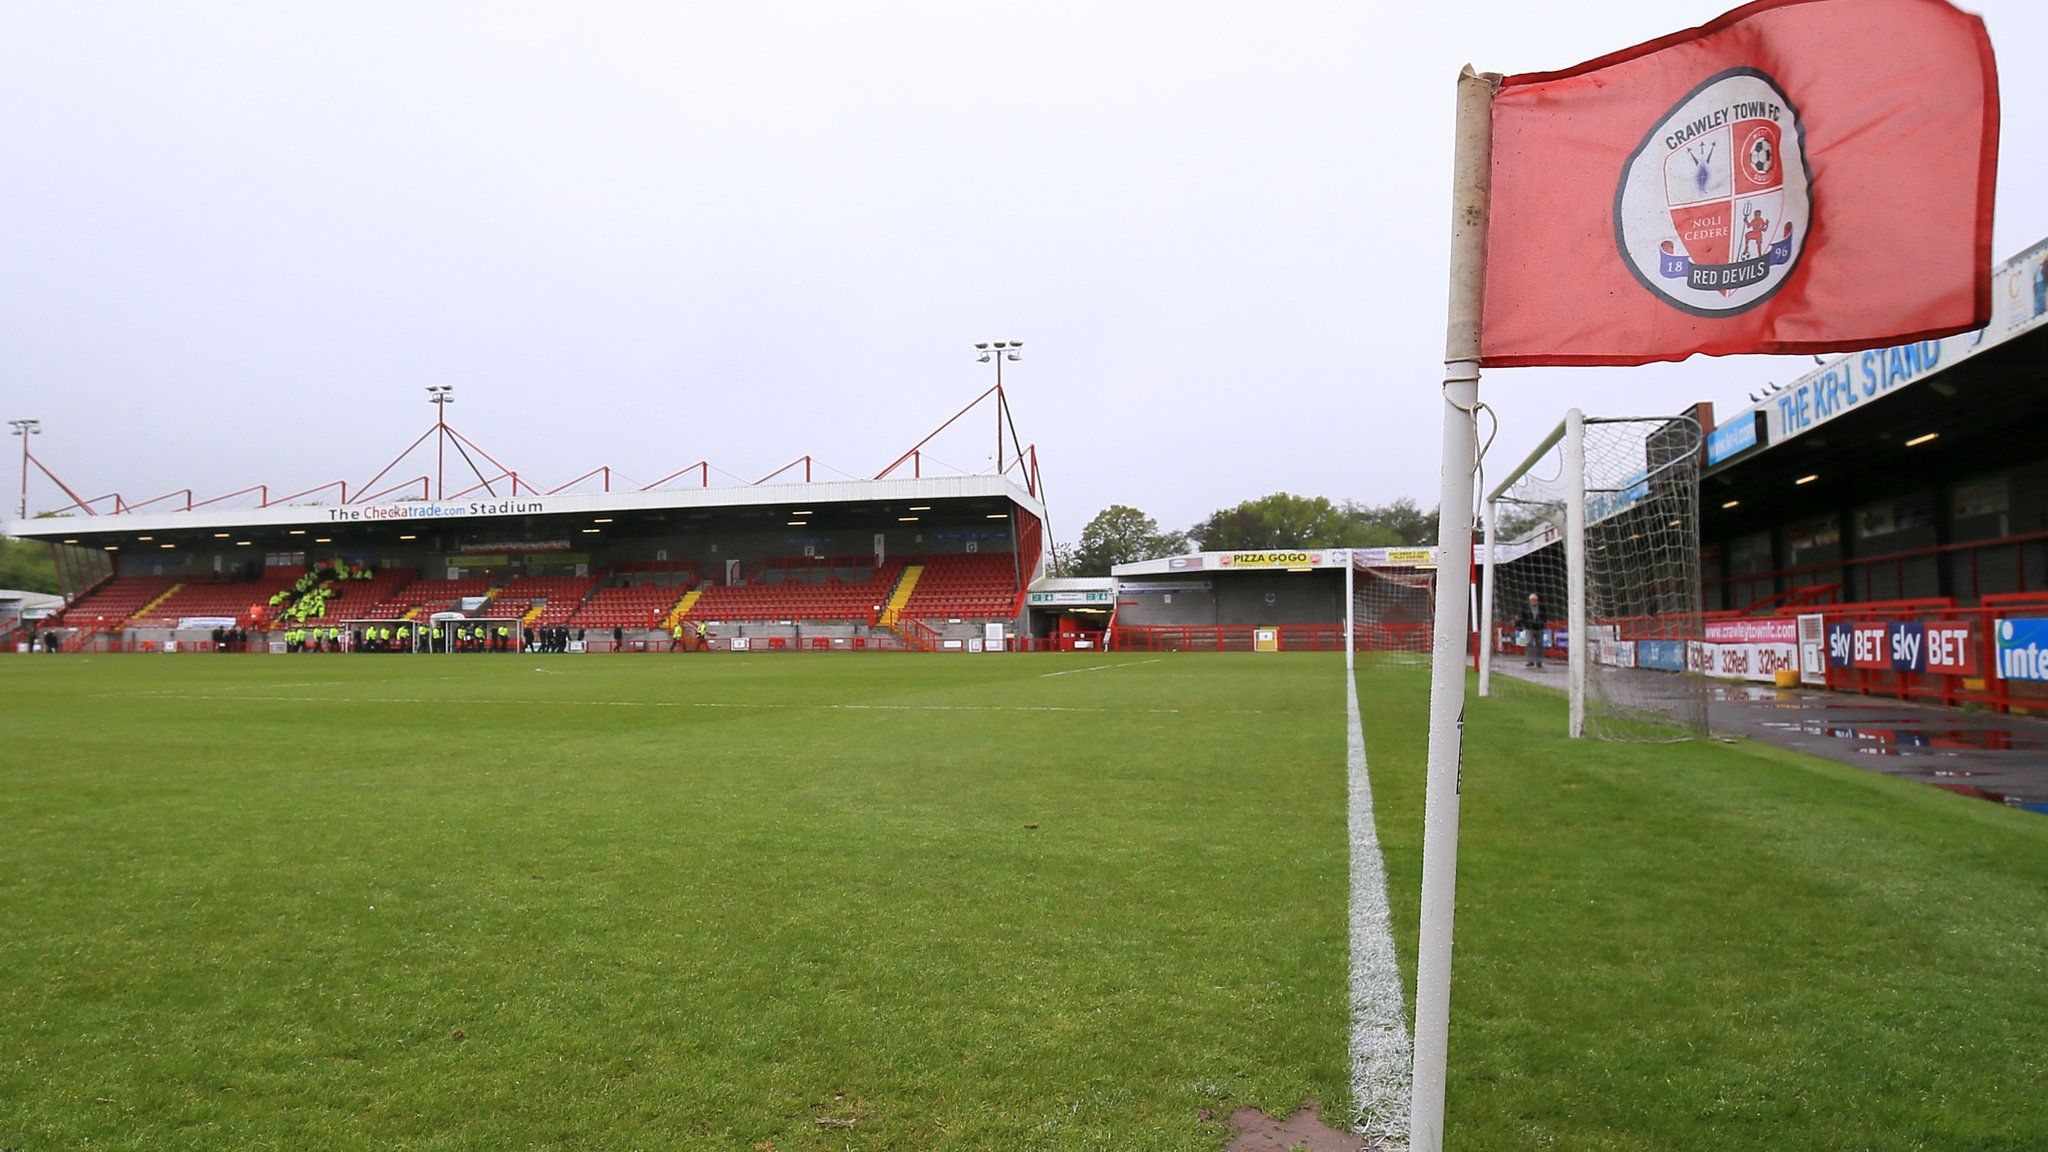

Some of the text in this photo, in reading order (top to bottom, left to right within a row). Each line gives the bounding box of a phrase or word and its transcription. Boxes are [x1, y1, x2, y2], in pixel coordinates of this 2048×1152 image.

[1665, 102, 1780, 150] CRAWLEY TOWN FC
[1684, 226, 1729, 241] CEDERE
[1693, 216, 1721, 228] NOLI
[1667, 247, 1788, 272] 18 96
[1693, 261, 1766, 285] RED DEVILS
[1778, 339, 1940, 435] THE KR-L STAND
[328, 500, 543, 520] The Checkatrade.com Stadium
[1233, 553, 1307, 563] PIZZA GOGO
[1705, 621, 1796, 641] www.crawleytownfc.com
[1830, 626, 1850, 665] sky
[1855, 630, 1885, 661] BET
[1892, 625, 1968, 670] sky BET
[1722, 649, 1748, 673] 32Red
